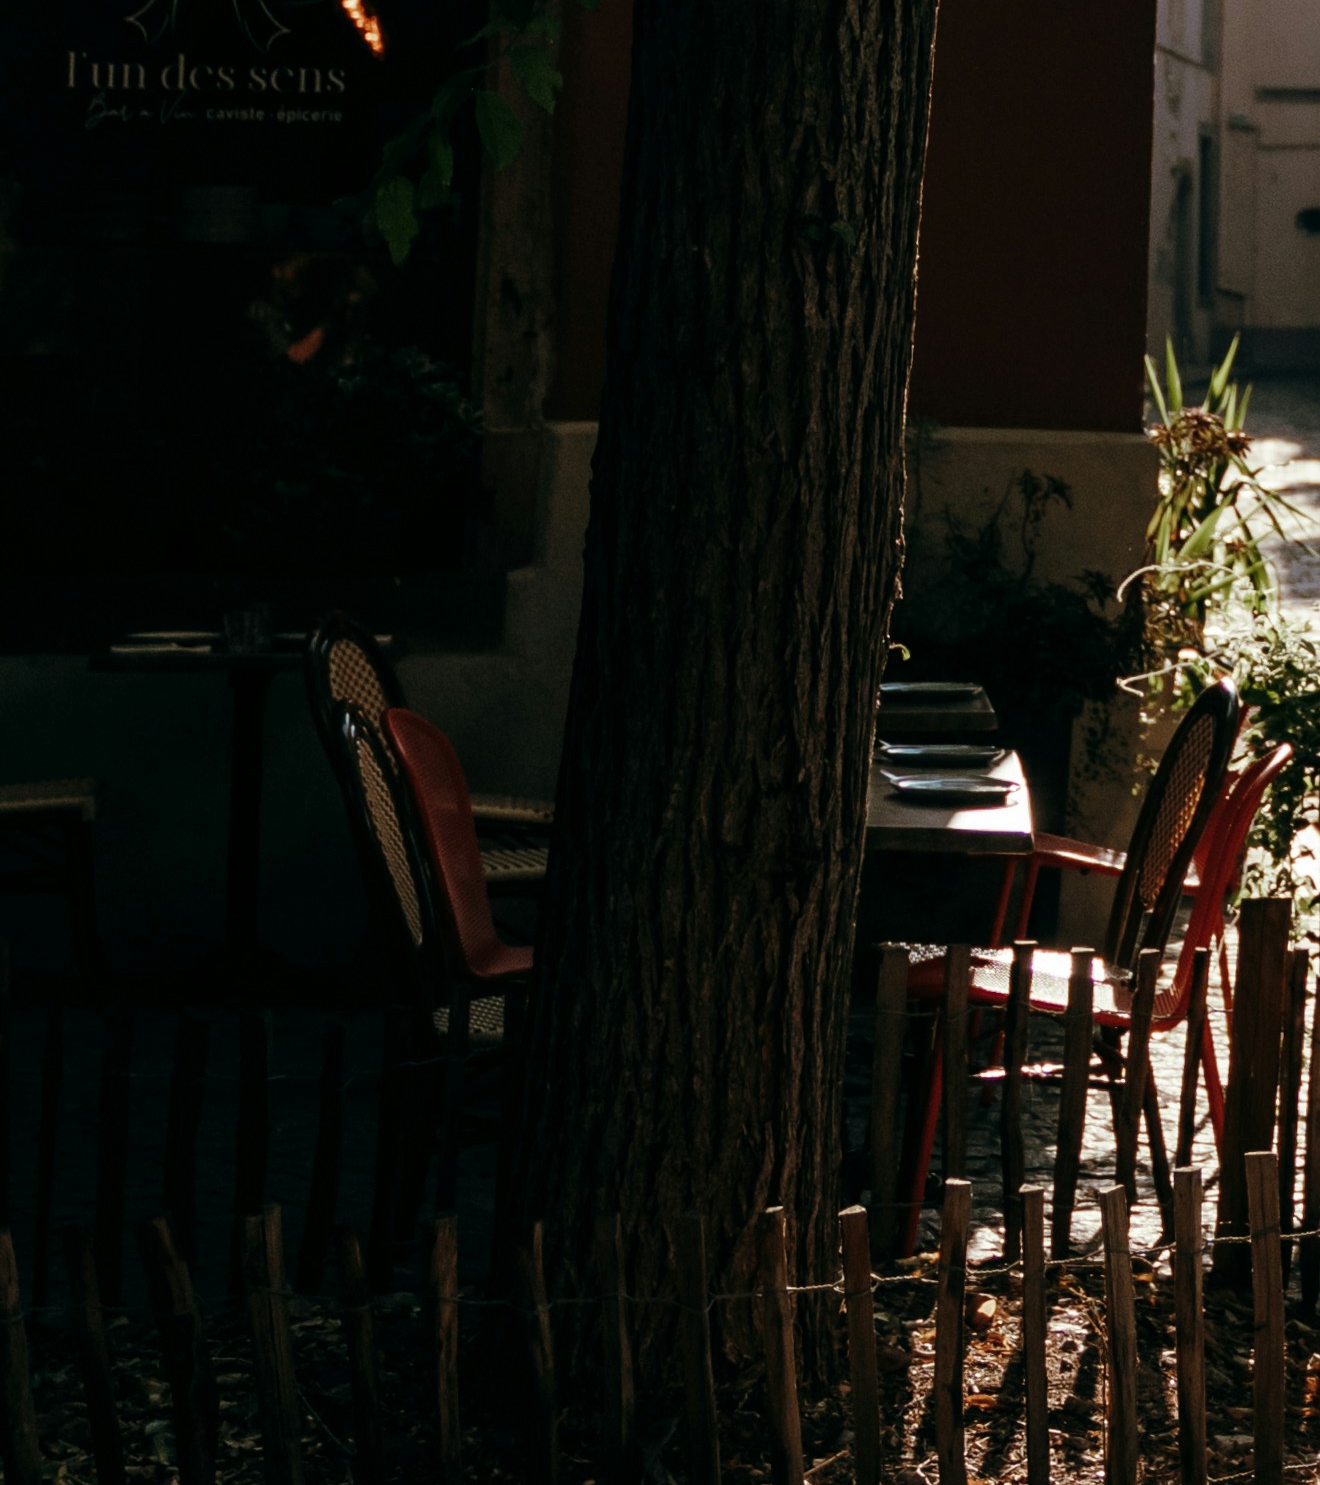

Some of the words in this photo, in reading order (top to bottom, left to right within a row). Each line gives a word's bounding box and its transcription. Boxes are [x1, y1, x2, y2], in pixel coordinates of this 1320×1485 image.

[67, 48, 147, 90] l'un
[160, 52, 237, 92] des
[247, 65, 348, 94] sens
[206, 106, 267, 123] caviste
[276, 104, 345, 126] épicerie
